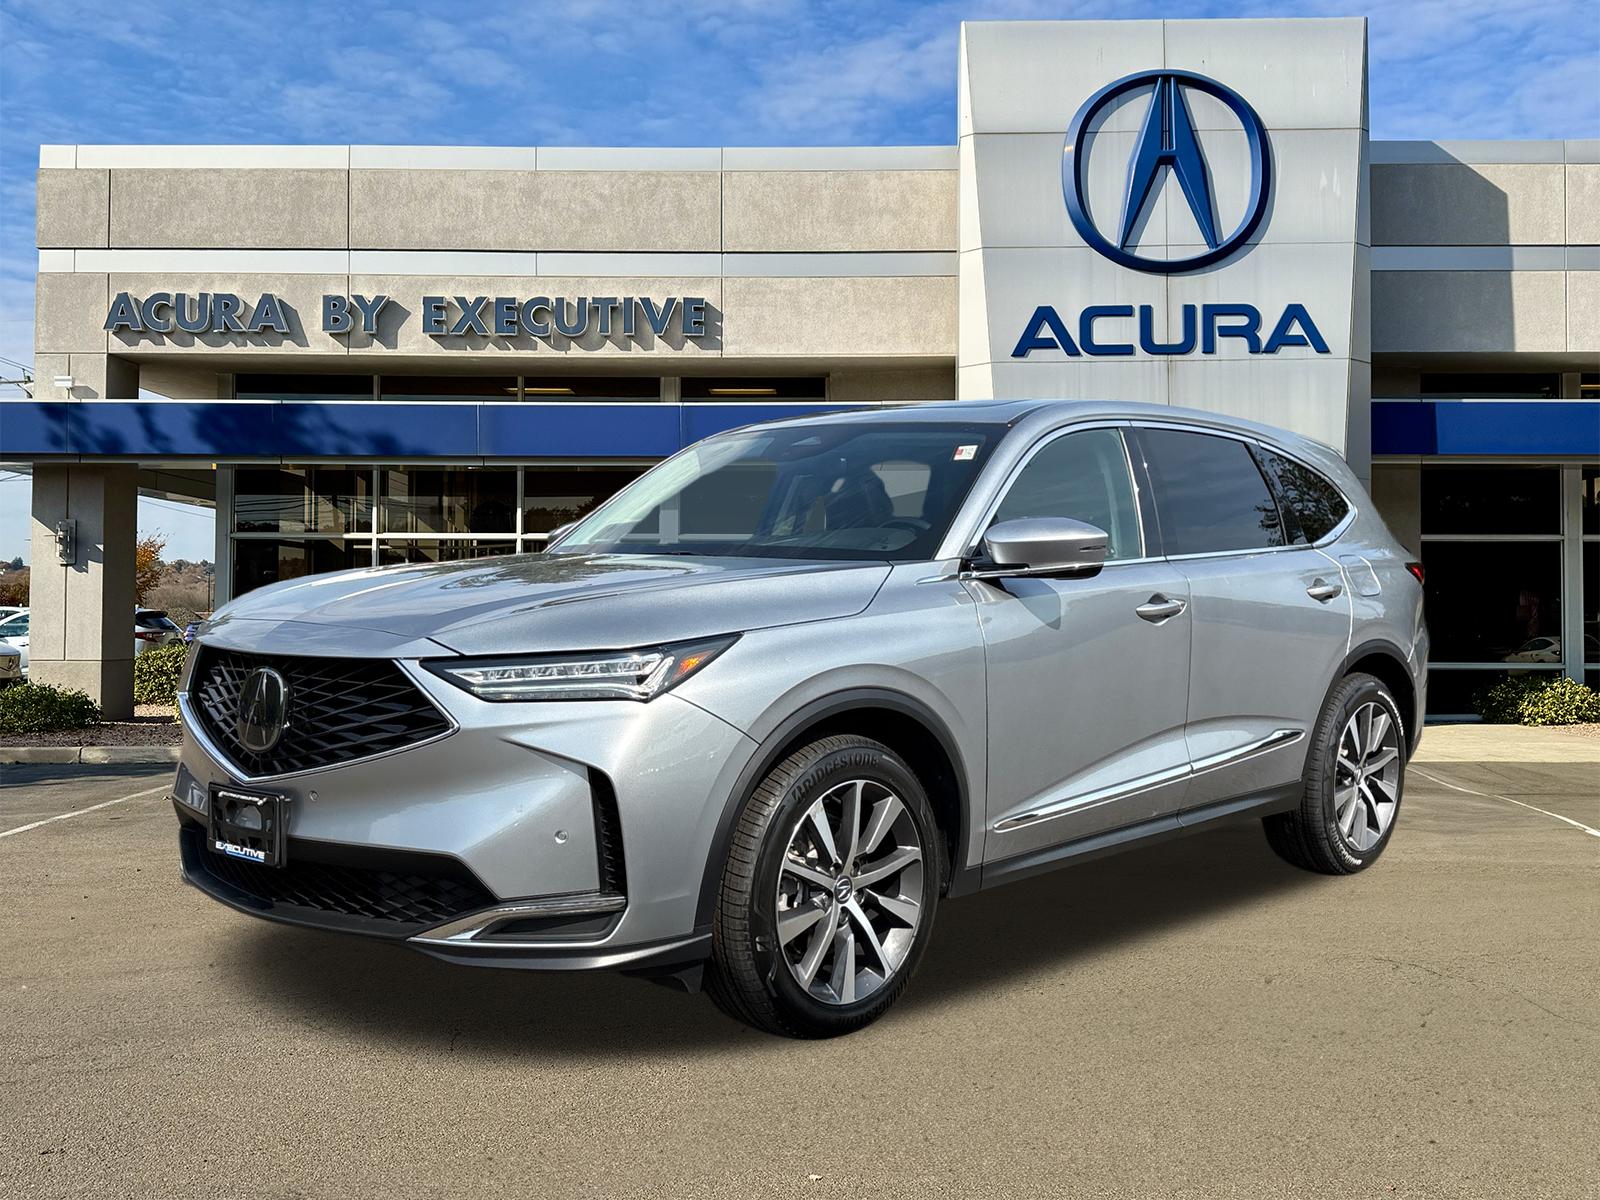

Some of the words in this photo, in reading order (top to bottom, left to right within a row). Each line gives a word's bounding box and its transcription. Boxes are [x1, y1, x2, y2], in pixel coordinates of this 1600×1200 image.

[104, 291, 290, 334] ACURA
[322, 295, 389, 335] BY
[422, 296, 708, 337] EXECUTIVE
[1011, 303, 1332, 357] ACURA
[215, 841, 265, 859] EXECUTIVE
